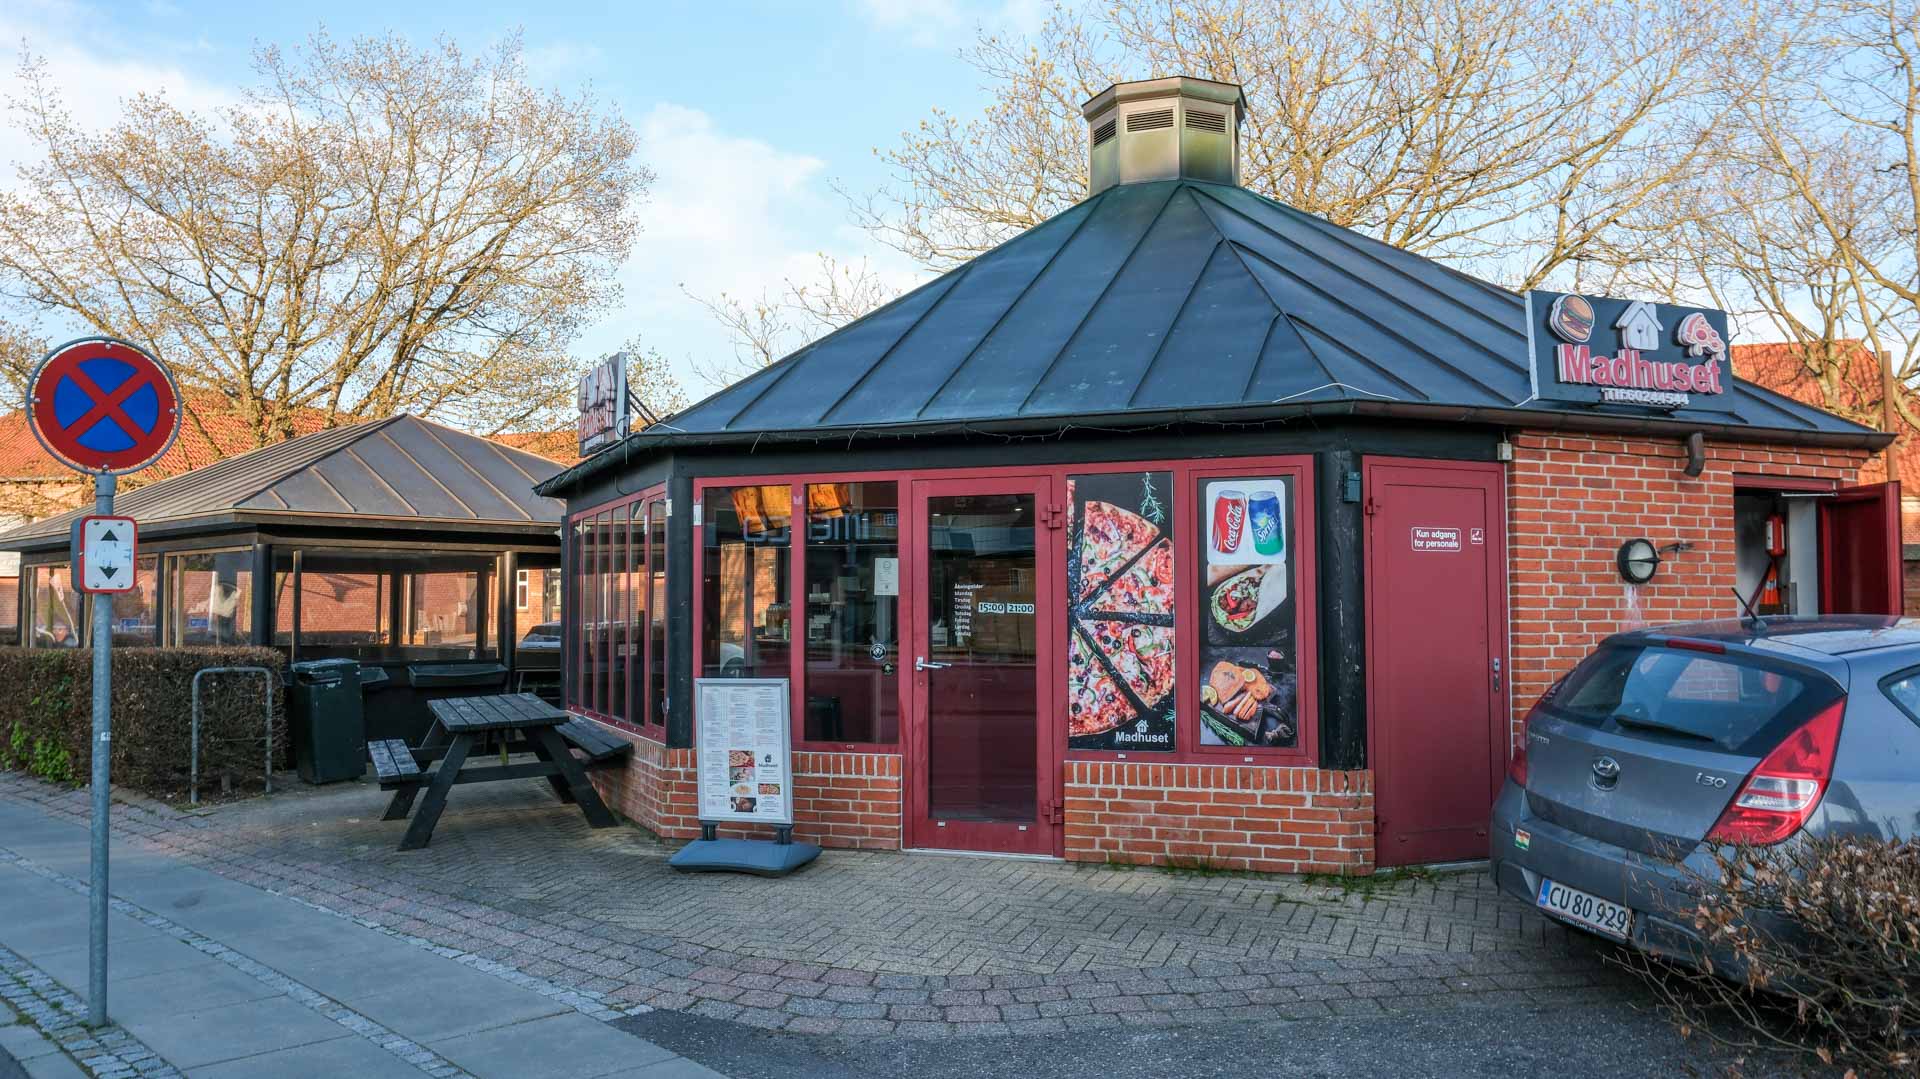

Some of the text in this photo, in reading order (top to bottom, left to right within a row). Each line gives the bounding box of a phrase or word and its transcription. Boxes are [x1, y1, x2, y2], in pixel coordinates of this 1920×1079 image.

[1557, 343, 1723, 394] Madhuset
[1257, 516, 1277, 542] Sprite
[1416, 529, 1456, 540] Kun adgang
[1414, 539, 1459, 549] for personale
[980, 603, 1033, 612] 15:00 21:00
[1115, 731, 1169, 743] Madhuset
[1695, 772, 1727, 788] i30
[1550, 887, 1571, 909] CU
[1572, 895, 1592, 918] 80
[1597, 903, 1626, 930] 929
